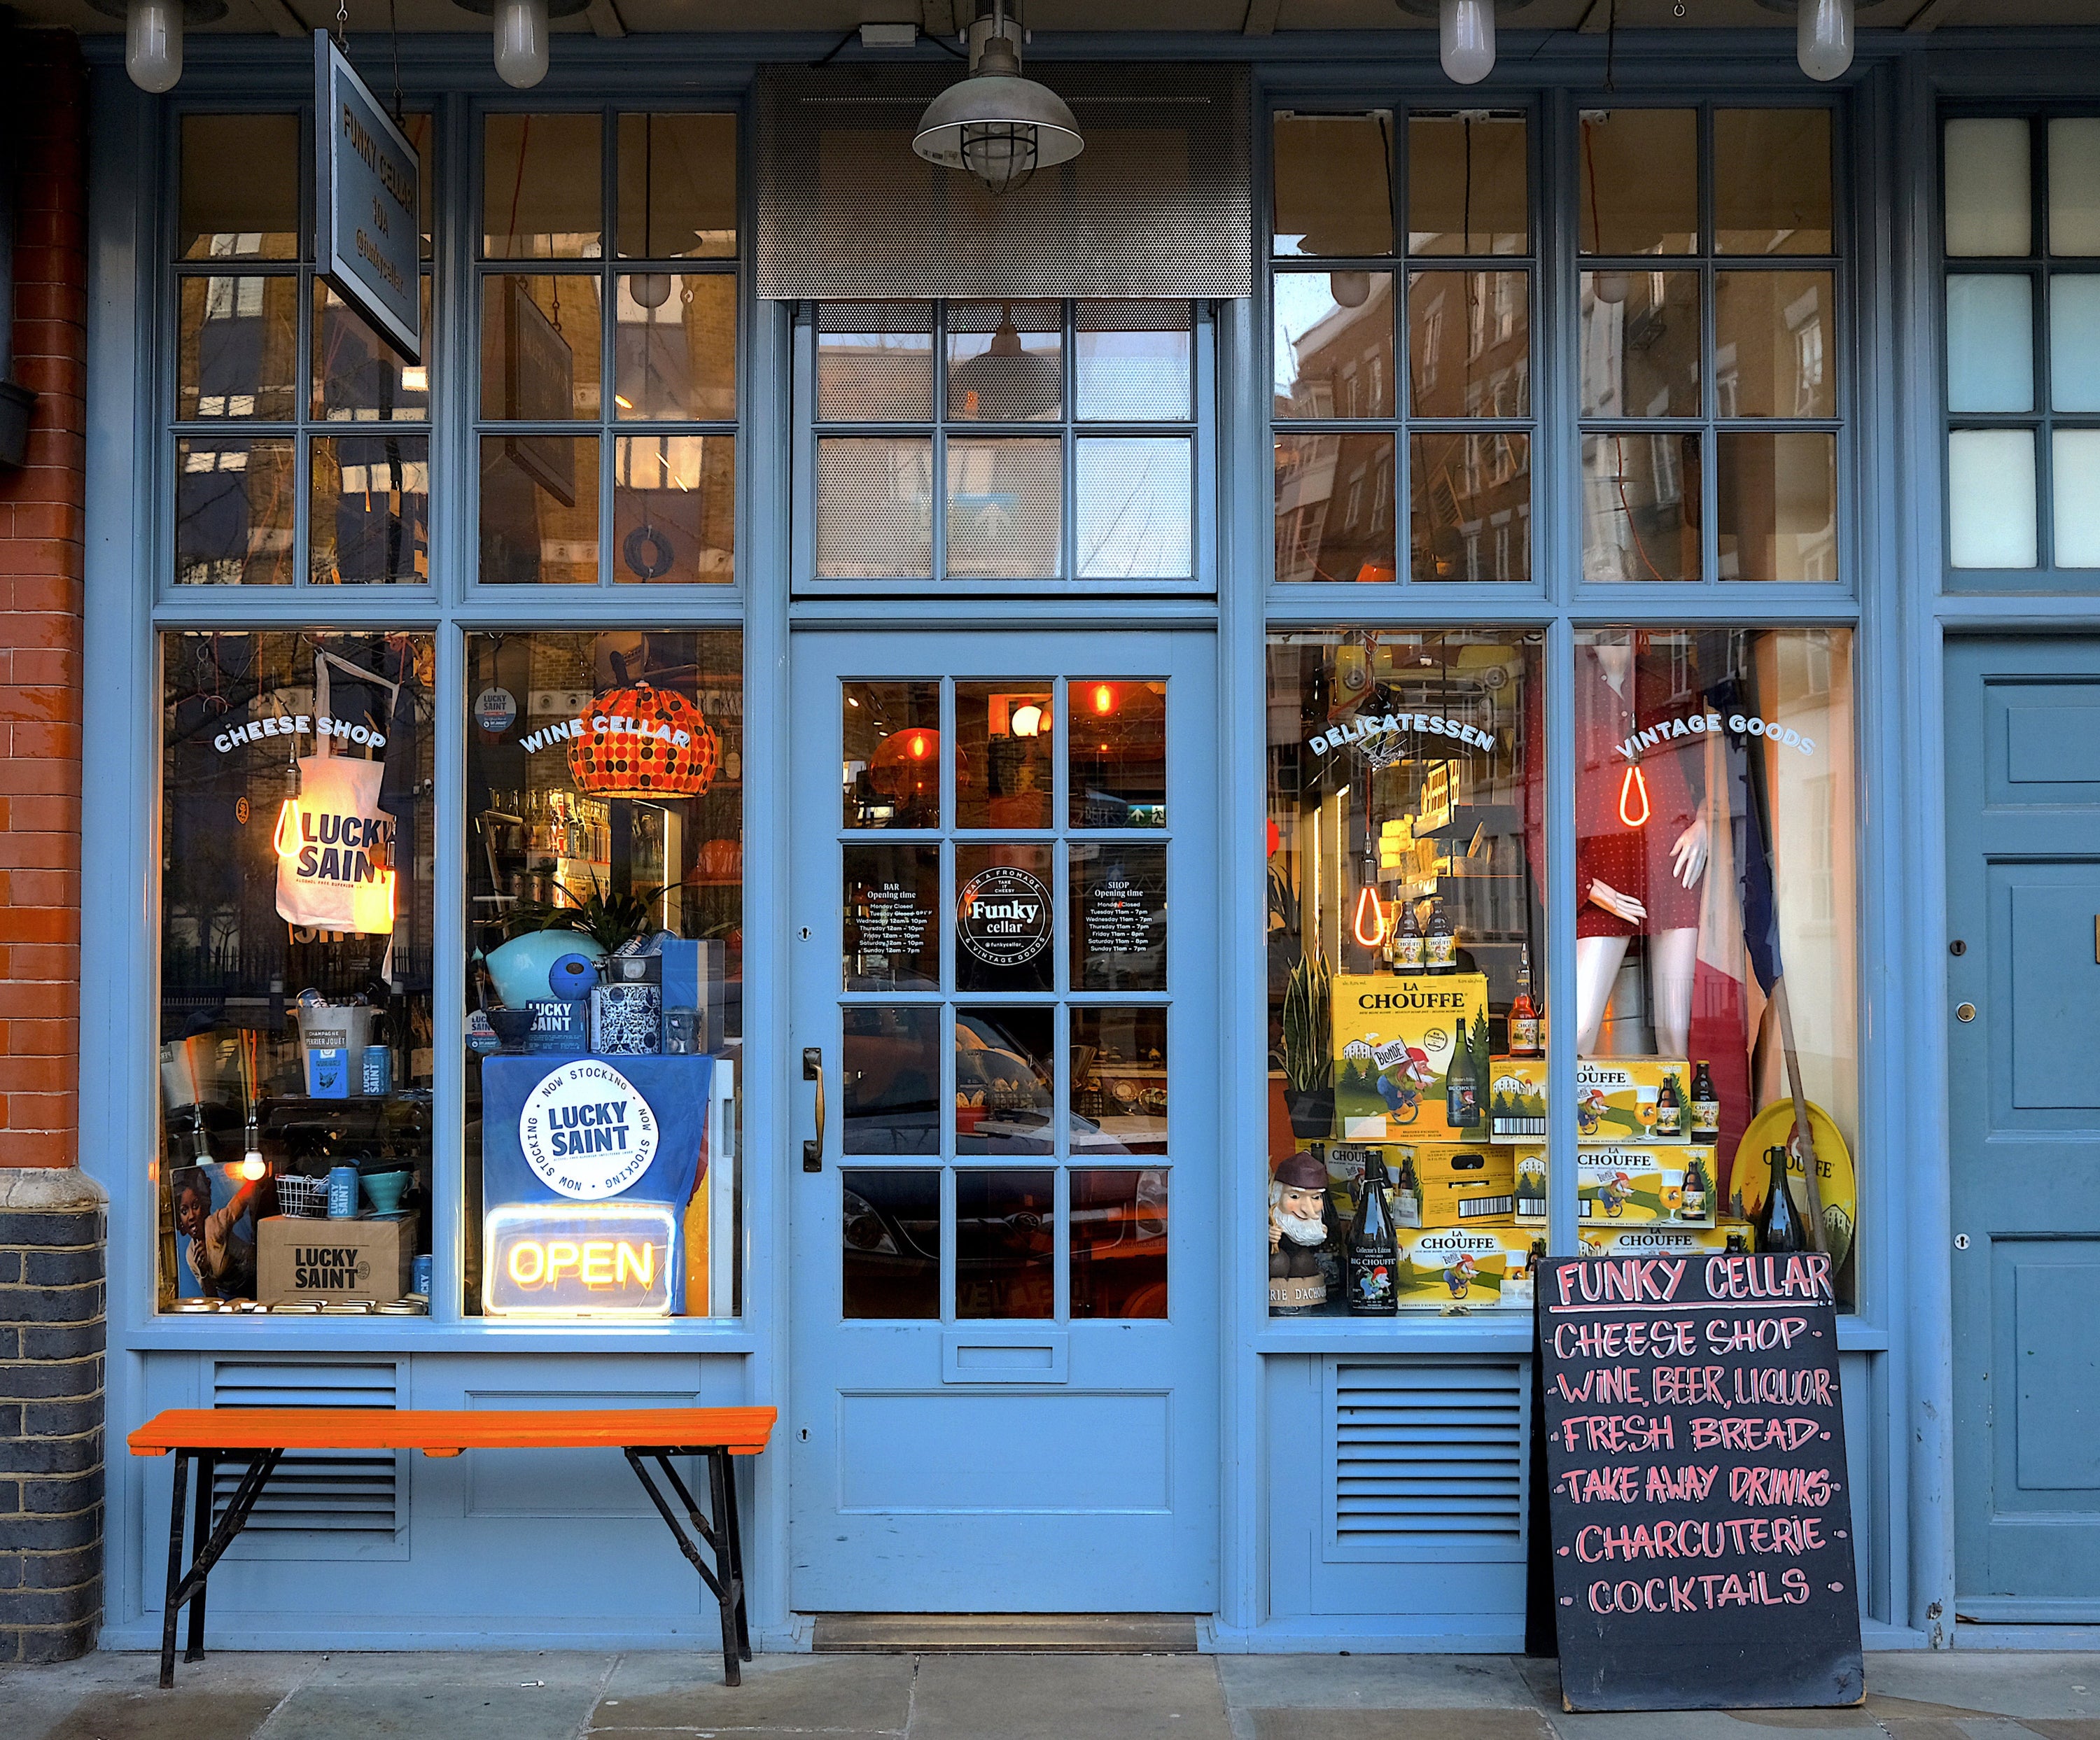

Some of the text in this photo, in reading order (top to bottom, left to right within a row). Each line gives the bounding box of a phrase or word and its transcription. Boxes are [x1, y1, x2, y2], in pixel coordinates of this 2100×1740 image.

[343, 103, 414, 218] FUNKY CELLAR
[372, 195, 389, 239] 10A
[214, 715, 386, 753] CHEESE SHOP
[519, 715, 691, 754] WINE CELLAR
[1308, 714, 1495, 756] DELICATESSEN
[1615, 714, 1816, 759] VINTAGE GOODS
[302, 813, 392, 848] LUCKY
[297, 846, 386, 884] SAIN
[868, 891, 898, 900] Opening
[966, 879, 981, 894] BAR
[997, 870, 1040, 890] FROMAGE
[1095, 890, 1126, 898] Opening
[972, 900, 1039, 923] Funky
[987, 921, 1023, 933] cellar
[973, 946, 1012, 963] VINTAGE
[1018, 937, 1045, 960] GOODS
[1359, 993, 1464, 1009] CHOUFFE
[1404, 983, 1418, 991] LA
[1375, 1043, 1403, 1065] BLONDE
[370, 1064, 379, 1093] SAINT
[542, 1067, 627, 1097] NOW STOCKING
[1577, 1073, 1625, 1083] OUFFE
[549, 1101, 627, 1130] LUCKY
[528, 1117, 555, 1177] STOCKING
[552, 1125, 629, 1156] SAINT
[605, 1109, 651, 1188] NOW STOCKING
[1332, 1150, 1366, 1162] CHOUF
[1578, 1155, 1651, 1166] CHOUFFE
[559, 1176, 582, 1191] NOW
[330, 1184, 339, 1214] LUCKY
[339, 1184, 349, 1214] SAINT
[1421, 1238, 1494, 1249] CHOUFFE
[1620, 1235, 1693, 1246] CHOUFFE
[295, 1249, 358, 1267] LUCKY
[508, 1240, 655, 1284] OPEN
[295, 1268, 358, 1289] SAINT
[421, 1275, 429, 1293] CKY
[1557, 1256, 1833, 1306] FUNKY CELLAR
[1553, 1317, 1808, 1359] CHEESE SHOP
[1653, 1365, 1732, 1411] BEER,
[1735, 1368, 1833, 1407] LIQUOR
[1562, 1415, 1820, 1454] FRESH BREAD
[1561, 1466, 1831, 1507] TAKE AWAY DRINKS
[1576, 1515, 1826, 1563] CHARCUTERIE
